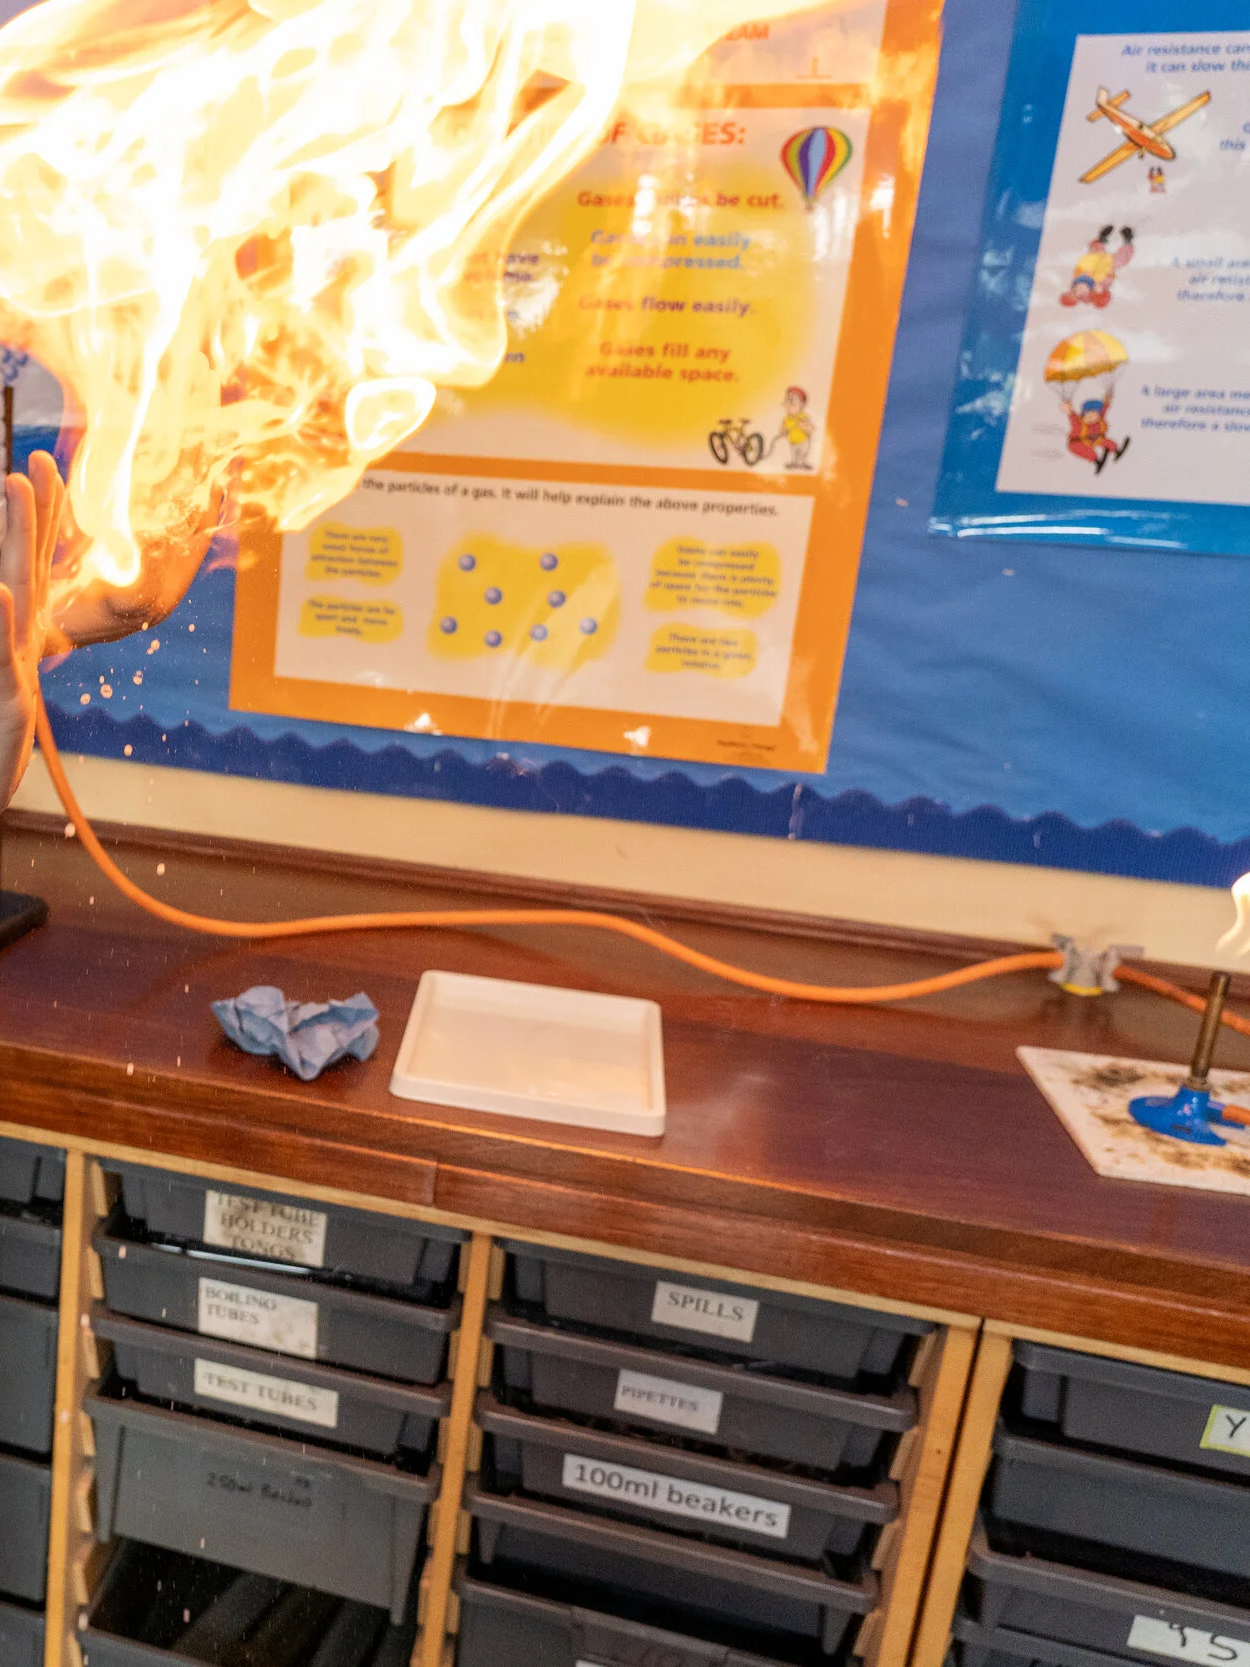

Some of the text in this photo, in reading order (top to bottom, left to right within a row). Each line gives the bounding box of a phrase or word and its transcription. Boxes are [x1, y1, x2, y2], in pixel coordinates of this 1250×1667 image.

[1121, 43, 1142, 55] Air
[1147, 44, 1221, 55] resistance
[1161, 63, 1186, 73] can
[1191, 62, 1225, 73] slow
[1220, 139, 1246, 152] this
[715, 190, 741, 207] be
[746, 192, 785, 210] cut.
[693, 229, 752, 250] easily
[1177, 290, 1245, 301] therefore
[641, 296, 687, 312] flow
[692, 297, 756, 318] easily.
[599, 340, 732, 364] Gases fill any
[584, 362, 739, 384] available space.
[1155, 385, 1190, 400] large
[1195, 388, 1225, 399] area
[1163, 403, 1180, 414] air
[1141, 418, 1207, 431] therefore
[362, 477, 384, 491] the
[387, 480, 440, 495] particles
[444, 482, 458, 496] of
[460, 487, 468, 497] a
[472, 489, 496, 502] gas.
[515, 489, 539, 502] will
[542, 489, 571, 505] help
[575, 492, 625, 508] explain
[629, 494, 651, 509] the
[655, 498, 698, 511] above
[702, 500, 778, 517] properties.
[221, 1212, 315, 1245] HOLDERS
[206, 1287, 279, 1311] BOILING
[667, 1291, 744, 1321] SPILLS
[206, 1303, 260, 1325] TUBES
[206, 1372, 318, 1411] TEST TUBES
[620, 1385, 698, 1412] PIPETTES
[1226, 1413, 1247, 1438] Y
[574, 1463, 778, 1527] 100ml beakers
